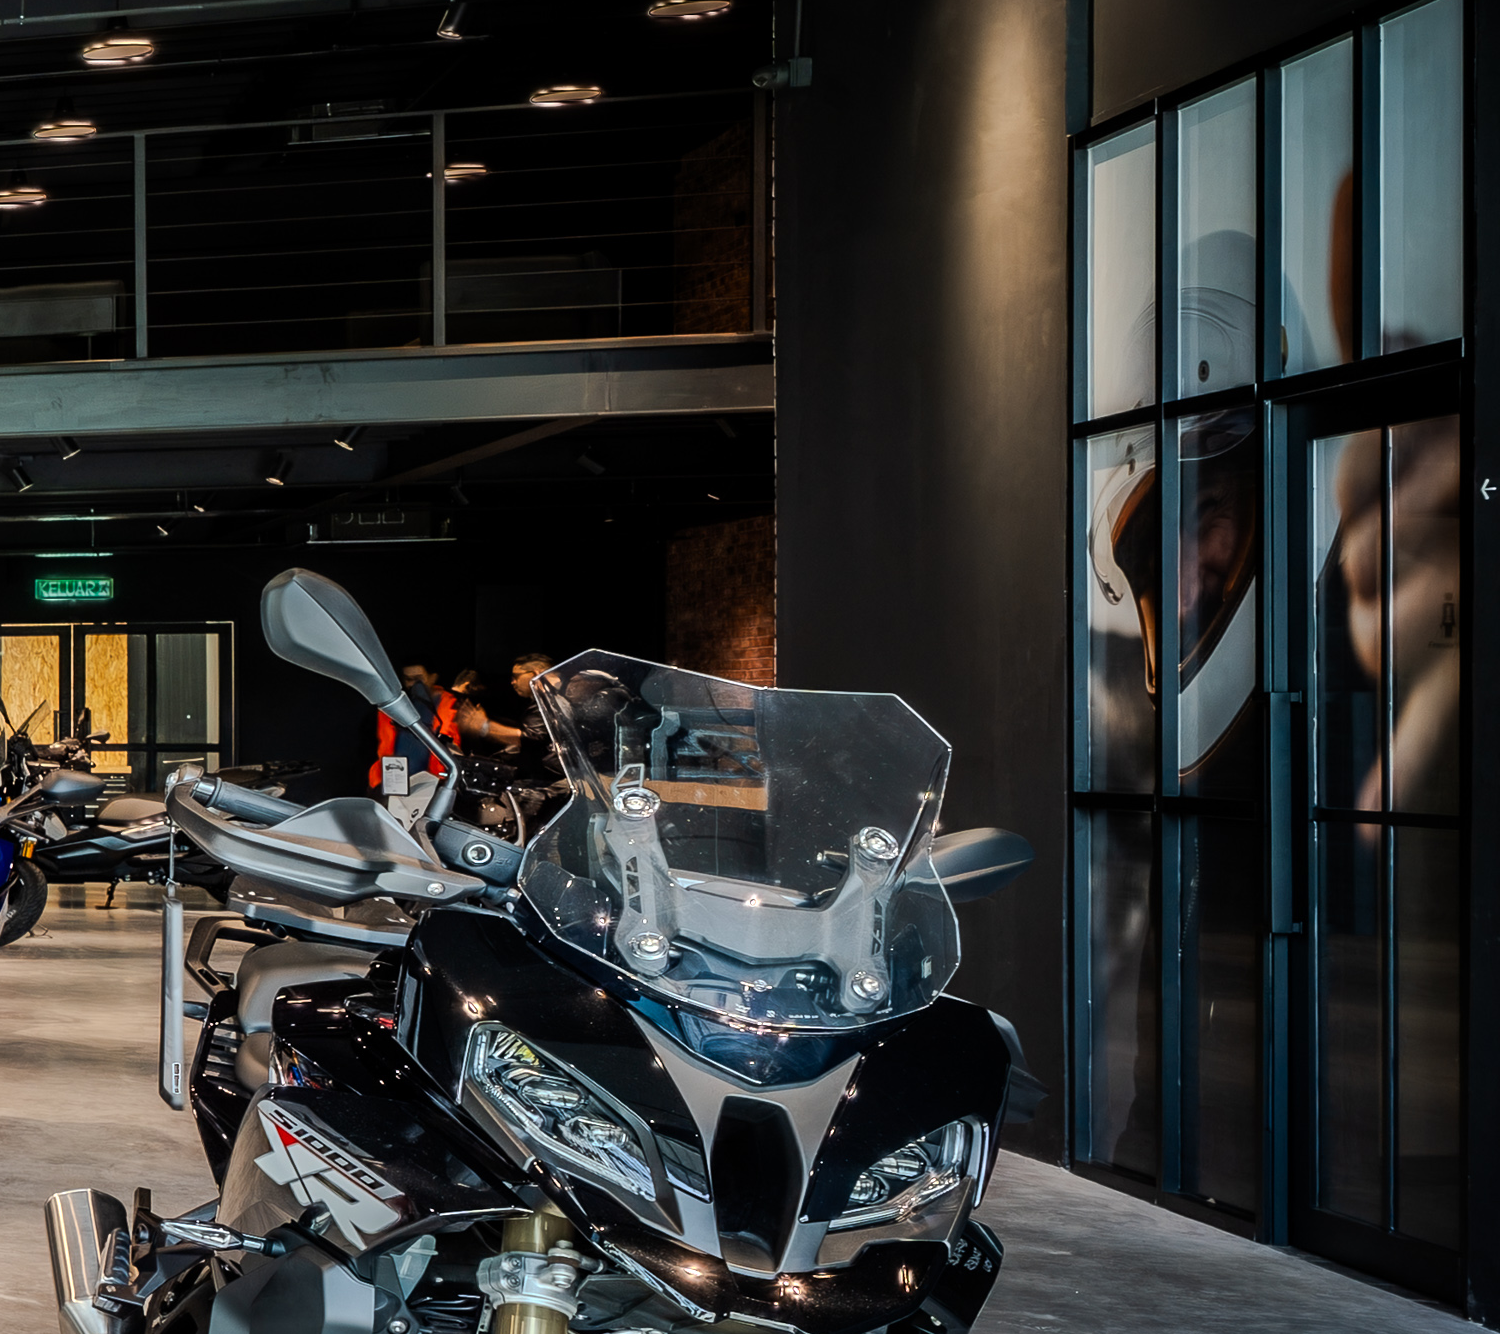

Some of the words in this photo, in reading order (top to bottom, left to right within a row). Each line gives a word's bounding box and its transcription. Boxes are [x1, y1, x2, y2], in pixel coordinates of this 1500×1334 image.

[38, 580, 96, 598] KELUAR
[253, 1104, 400, 1252] XR
[268, 1108, 386, 1191] S1000
